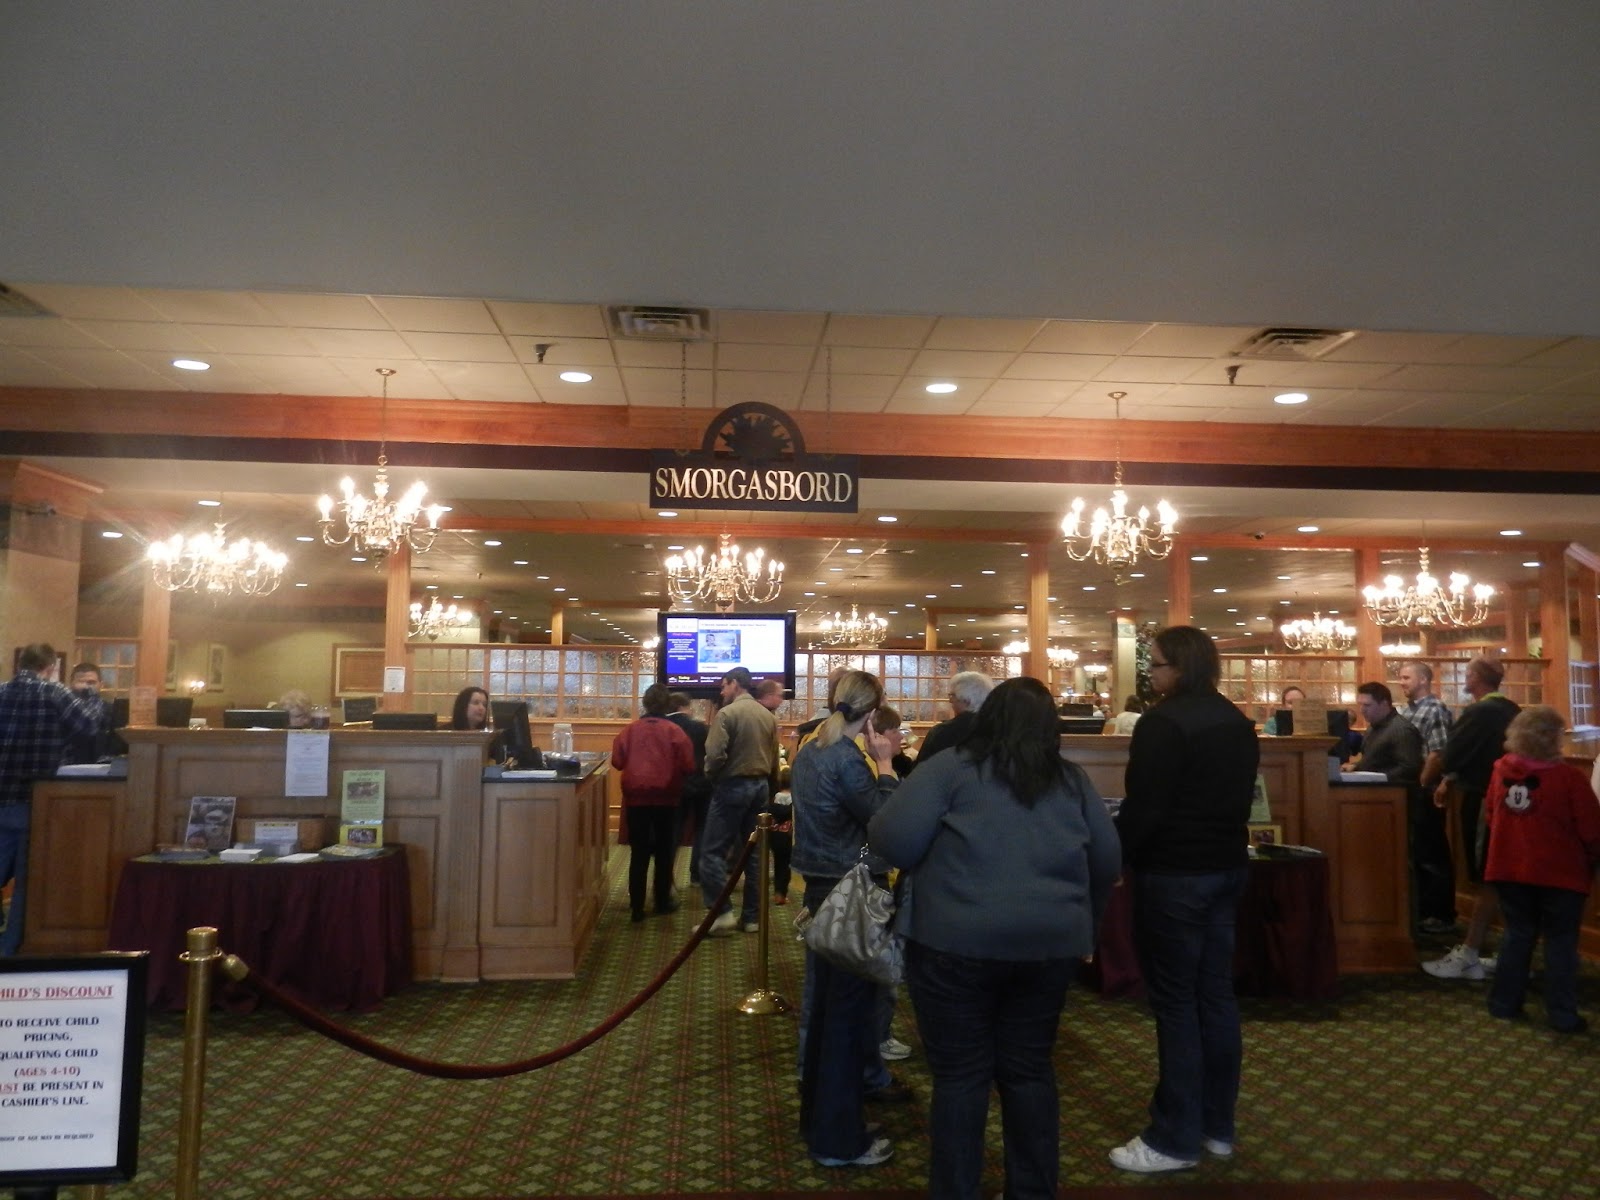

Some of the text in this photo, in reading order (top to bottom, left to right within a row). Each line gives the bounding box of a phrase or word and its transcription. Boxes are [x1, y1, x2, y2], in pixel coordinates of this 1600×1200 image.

[655, 467, 853, 503] SMORGASBORD
[45, 985, 114, 998] DISCOUNT
[0, 1016, 99, 1028] TO RECEIVE CHILD
[24, 1032, 73, 1042] PRICING,
[65, 1048, 98, 1058] CHILD
[14, 1066, 81, 1078] (AGES 4-10)
[23, 1082, 36, 1092] BE
[41, 1081, 89, 1091] PRESENT
[92, 1080, 104, 1090] IN
[1, 1096, 89, 1107] CASHIER'S LINE.
